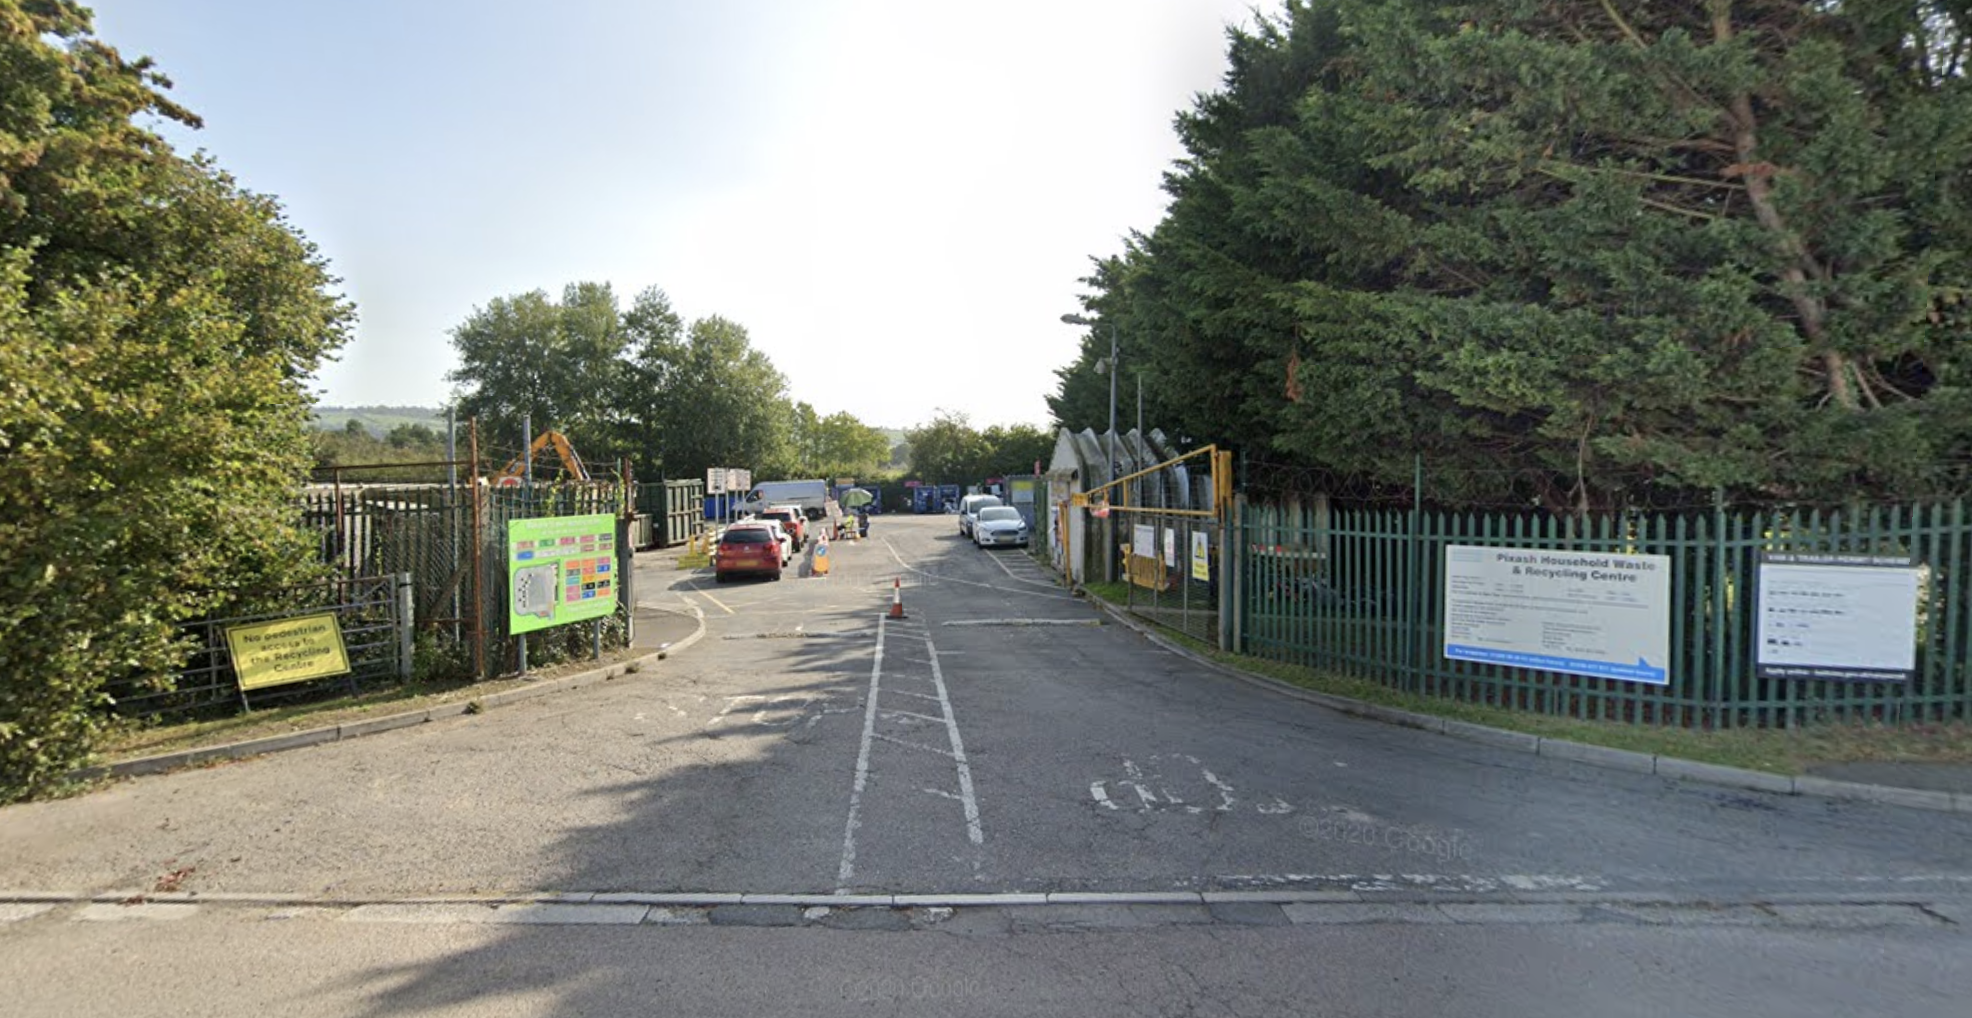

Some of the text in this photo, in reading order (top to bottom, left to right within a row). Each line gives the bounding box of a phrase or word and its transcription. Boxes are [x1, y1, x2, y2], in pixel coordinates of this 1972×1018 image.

[1496, 553, 1537, 563] Pixash
[1541, 555, 1609, 568] Household
[1612, 559, 1656, 570] Waste
[1512, 565, 1637, 582] & Recycling Centre
[243, 624, 326, 643] No pedestrian
[303, 637, 316, 646] to
[251, 646, 331, 665] the Recycling
[273, 659, 315, 672] Centre
